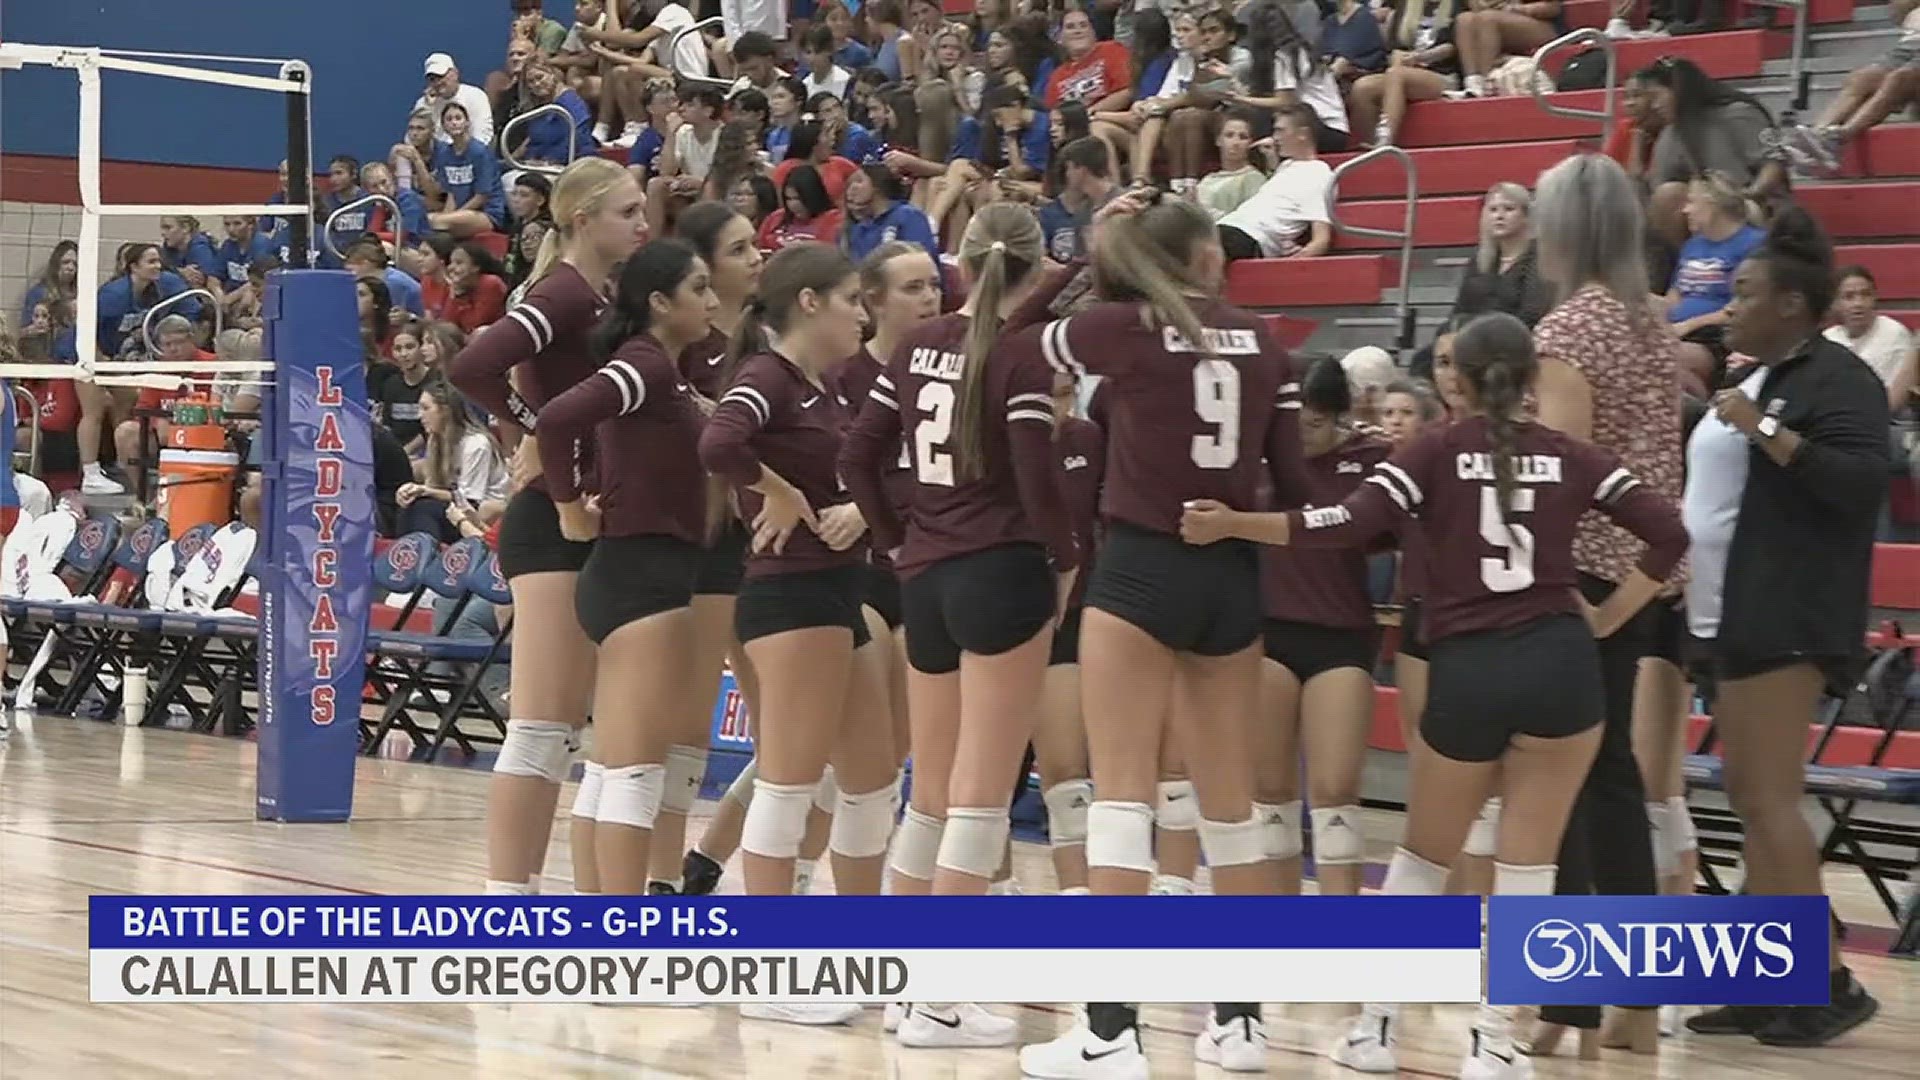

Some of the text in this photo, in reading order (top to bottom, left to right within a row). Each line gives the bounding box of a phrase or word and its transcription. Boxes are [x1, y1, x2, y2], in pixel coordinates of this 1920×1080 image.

[915, 381, 956, 487] 2
[1190, 359, 1241, 469] 9
[1456, 451, 1562, 482] CALLLEN
[309, 366, 344, 726] LADYCATS
[1478, 485, 1535, 593] 5
